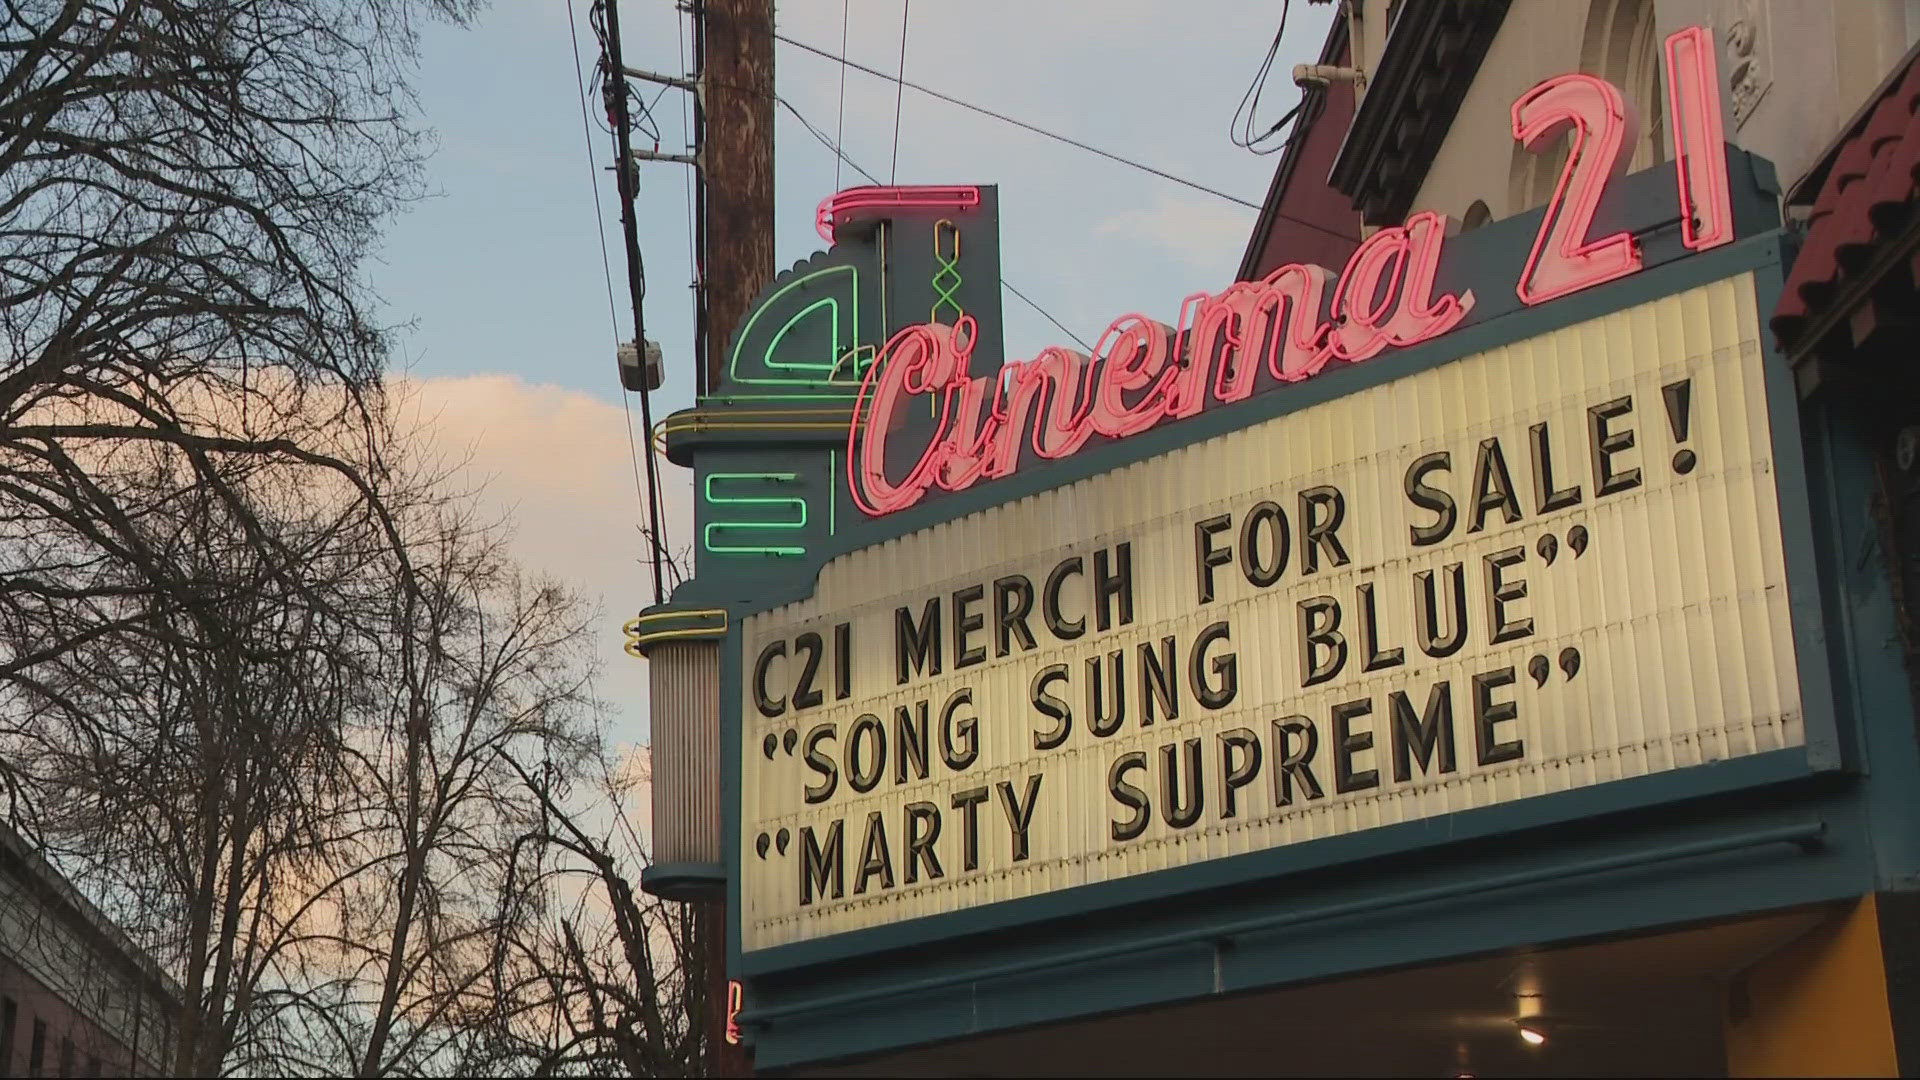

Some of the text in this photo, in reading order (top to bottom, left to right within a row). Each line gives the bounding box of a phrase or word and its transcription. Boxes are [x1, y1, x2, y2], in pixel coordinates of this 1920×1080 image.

[847, 26, 1735, 518] Cinema 21
[752, 378, 1698, 717] C21 MERCH FOR SALE!
[763, 524, 1590, 804] "SONG SUNG BLUE"
[756, 646, 1581, 906] "MARTY SUPREME"
